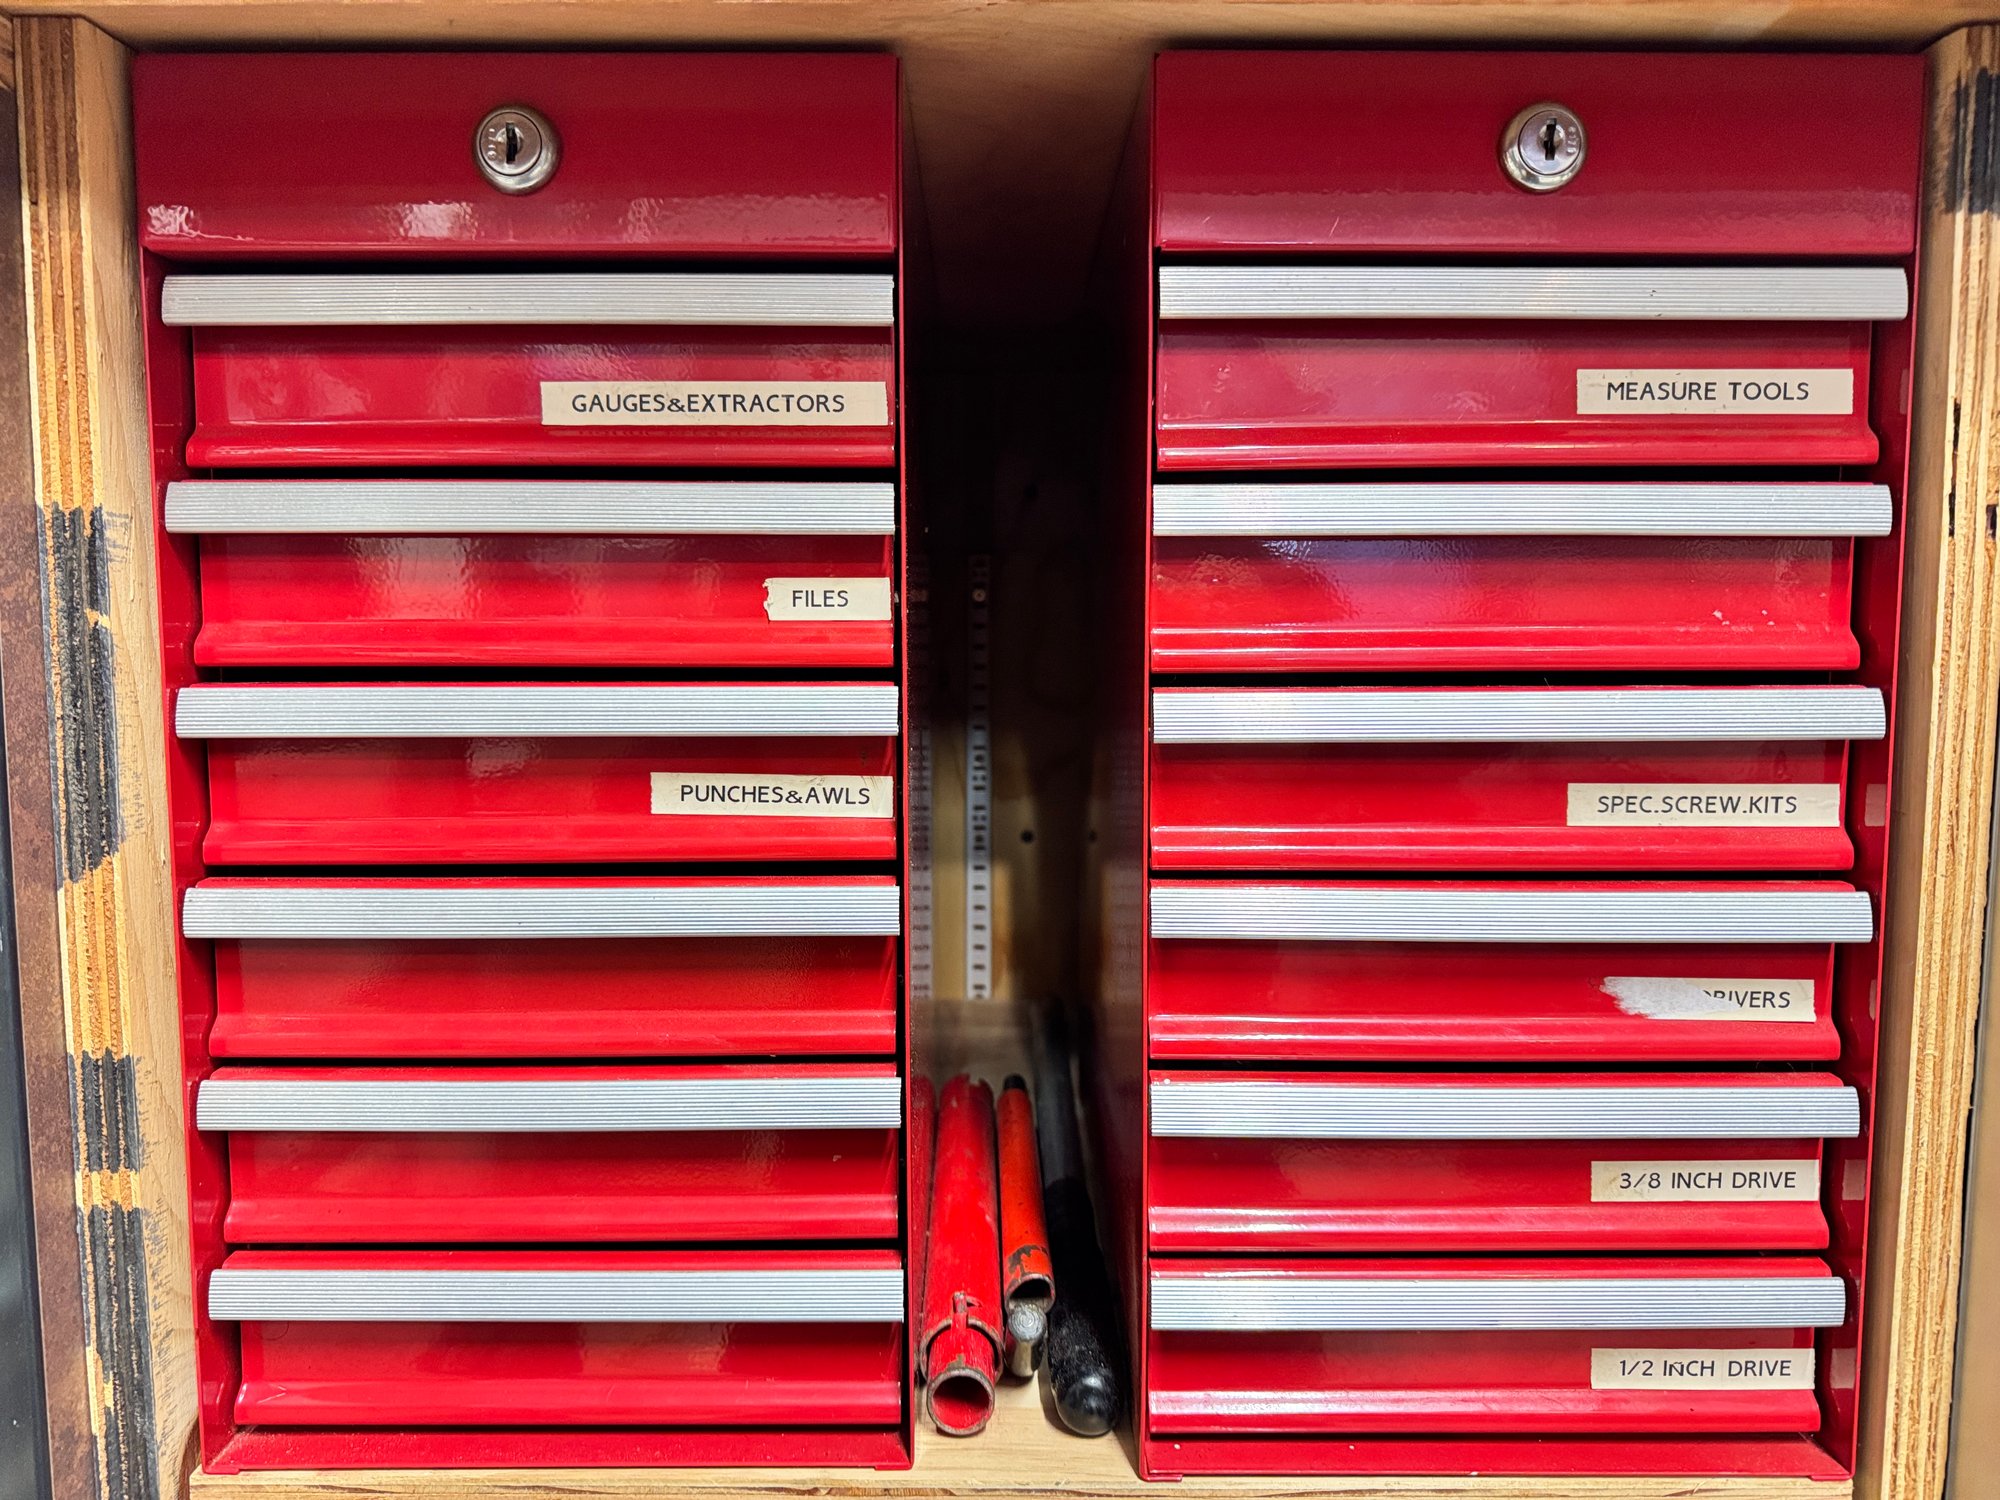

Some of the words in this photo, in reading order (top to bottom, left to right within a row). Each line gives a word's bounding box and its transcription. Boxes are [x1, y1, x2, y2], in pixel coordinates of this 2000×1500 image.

[1607, 381, 1717, 401] MEASURE
[1728, 381, 1809, 401] TOOLS
[571, 393, 845, 413] GAUGES&EXTRACTORS
[792, 589, 849, 608] FILES
[680, 784, 870, 805] PUNCHES&AWLS
[1597, 795, 1797, 814] SPEC.SCREW.KITS
[1695, 989, 1791, 1009] IVERS
[1619, 1172, 1661, 1190] 3/8
[1671, 1172, 1723, 1189] INCH
[1732, 1171, 1797, 1189] DRIVE
[1619, 1359, 1654, 1377] 1/2
[1663, 1359, 1715, 1377] INCH
[1728, 1360, 1792, 1377] DRIVE
